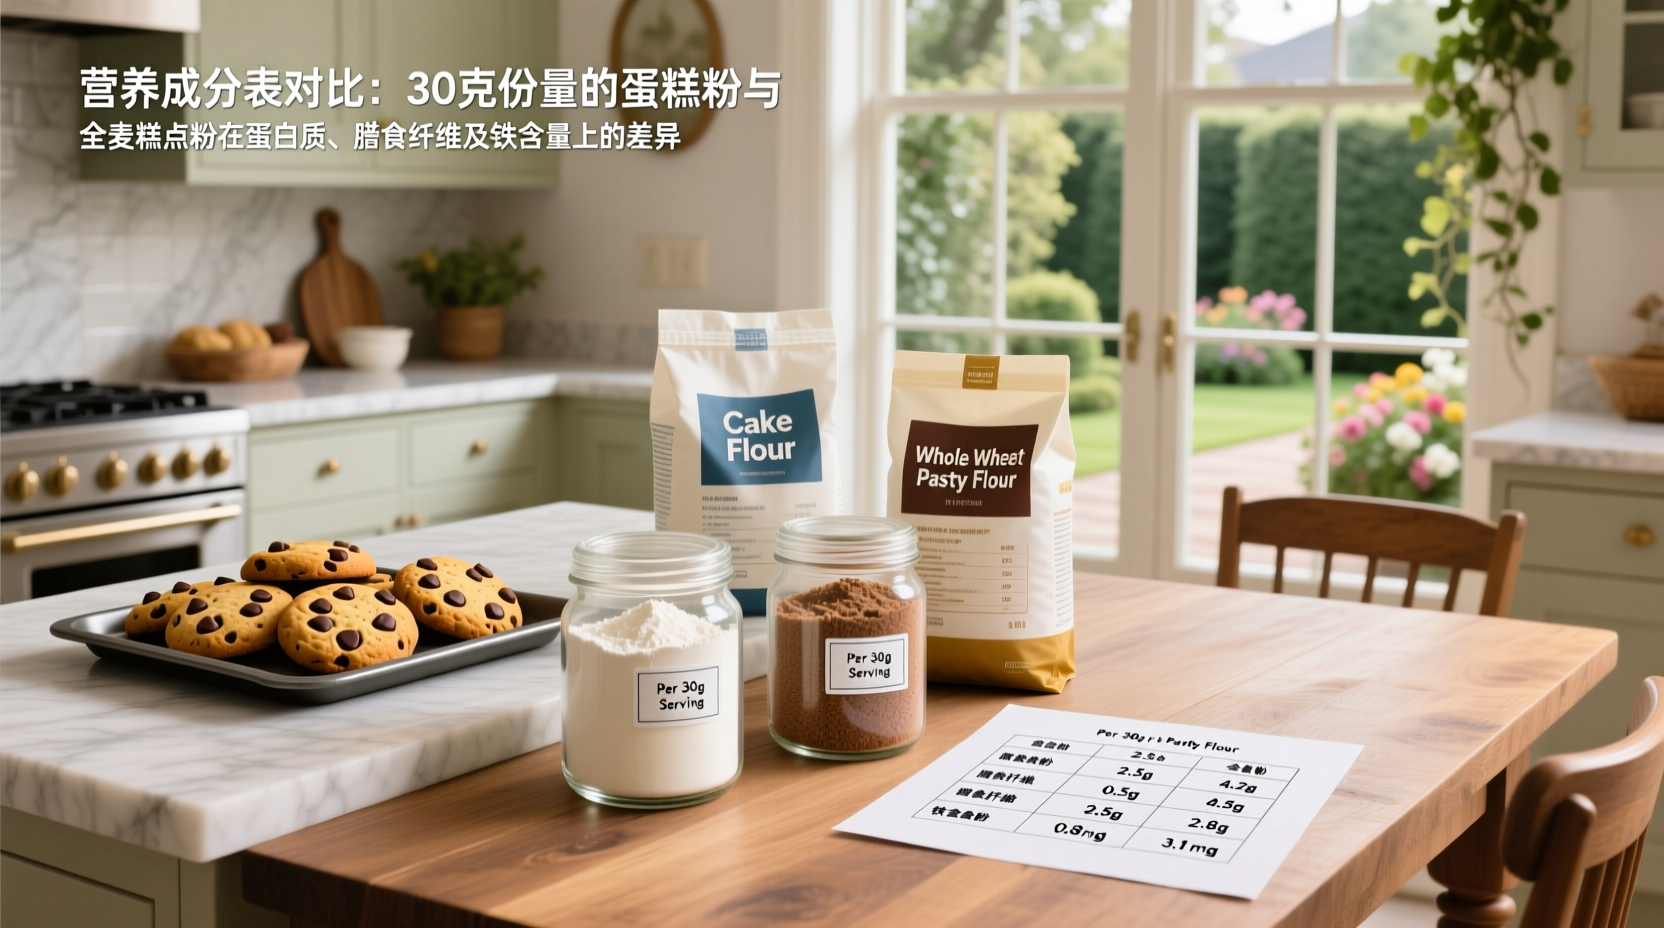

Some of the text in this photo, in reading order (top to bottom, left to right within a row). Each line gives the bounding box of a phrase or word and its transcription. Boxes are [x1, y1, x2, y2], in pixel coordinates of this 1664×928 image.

[722, 409, 793, 435] Cake
[726, 437, 796, 463] Flour
[916, 445, 970, 467] Whole
[916, 467, 1018, 494] Pasty Flour
[847, 651, 893, 665] Per 30g
[848, 667, 891, 679] Serving
[656, 680, 706, 695] Per 30g
[658, 696, 705, 712] Serving
[1204, 741, 1240, 753] Flour
[1116, 766, 1154, 781] 2.5g
[1102, 785, 1140, 801] 0.5g
[1083, 804, 1124, 821] 2.5g
[1205, 797, 1245, 814] 4.5g
[1054, 822, 1107, 843] 0.8mg
[1187, 817, 1230, 835] 2.8g
